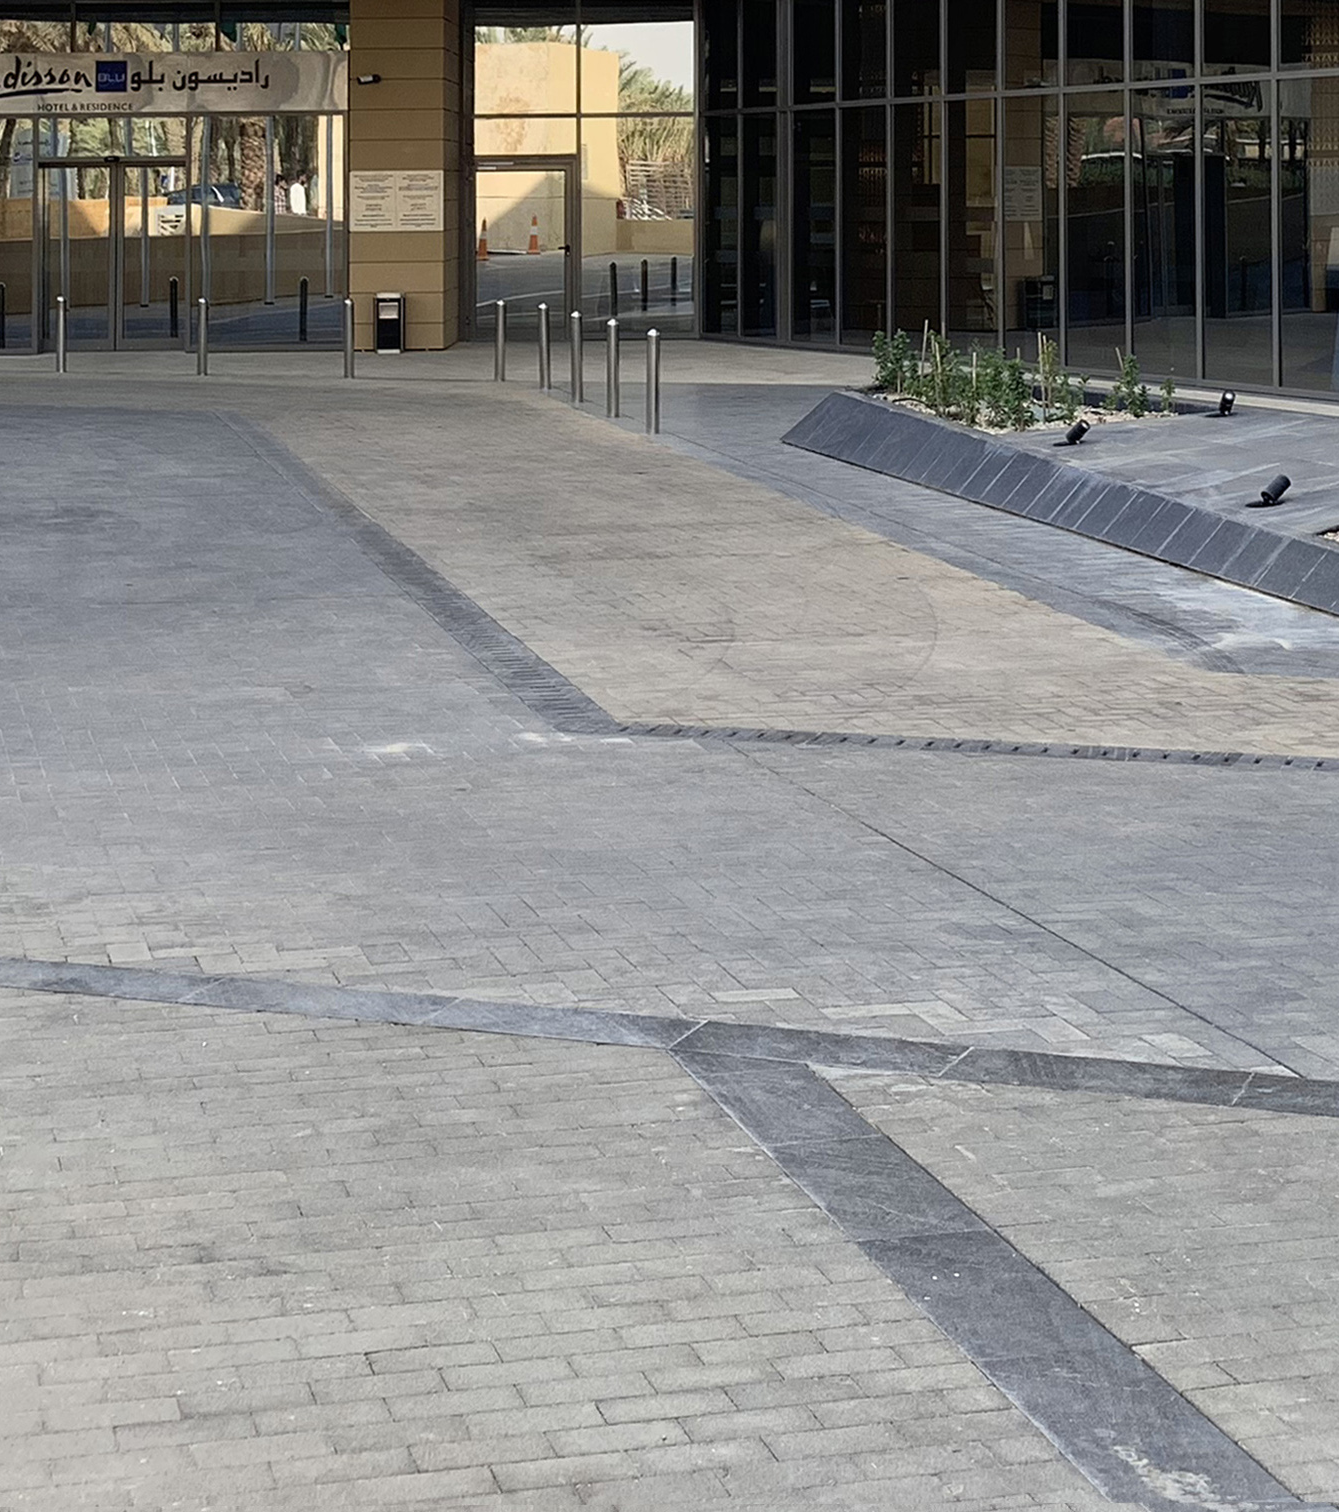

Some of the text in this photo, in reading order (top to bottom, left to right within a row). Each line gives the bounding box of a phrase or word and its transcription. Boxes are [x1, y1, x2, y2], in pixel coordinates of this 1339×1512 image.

[98, 72, 126, 83] BLU
[130, 59, 270, 92] راديسون بلو
[37, 102, 133, 112] HOTEL & RESIDENCE
